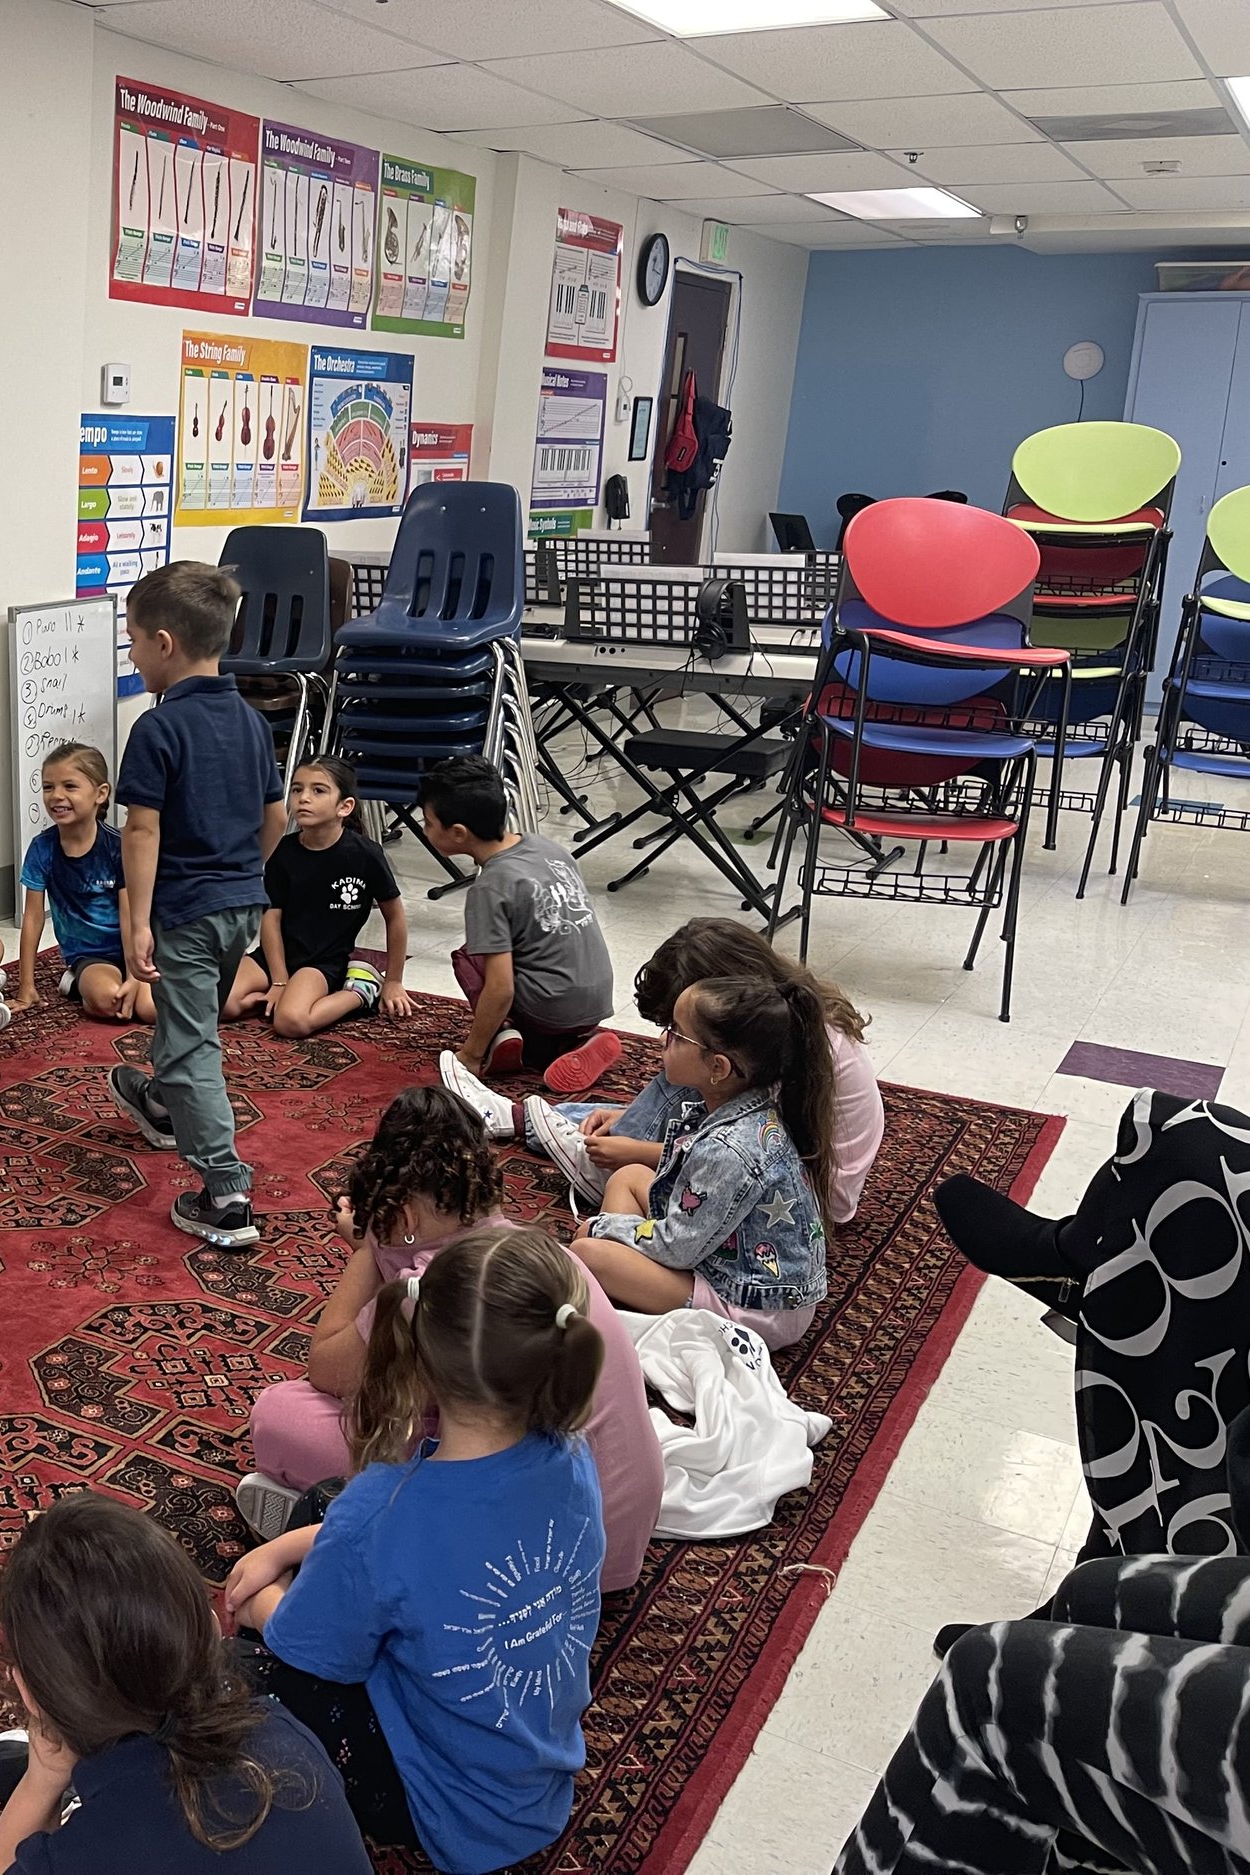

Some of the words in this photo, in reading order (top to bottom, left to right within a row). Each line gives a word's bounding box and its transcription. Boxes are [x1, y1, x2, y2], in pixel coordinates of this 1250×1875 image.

[120, 89, 136, 112] The
[137, 94, 184, 124] Woodwind
[184, 106, 208, 135] Family
[266, 130, 279, 150] The
[280, 135, 314, 161] Woodwind
[314, 143, 336, 168] Family
[383, 162, 394, 180] The
[394, 164, 411, 183] Brass
[411, 169, 430, 191] Family
[185, 340, 198, 358] The
[200, 342, 222, 364] String
[223, 344, 246, 366] Family
[314, 355, 326, 371] The
[327, 356, 355, 373] Orchestra
[412, 431, 438, 448] Dynamics
[81, 501, 96, 509] Largo
[79, 533, 98, 543] Adagio
[77, 567, 101, 575] Andante
[505, 1641, 508, 1649] I
[511, 1638, 525, 1648] Am
[526, 1618, 553, 1642] Grateful
